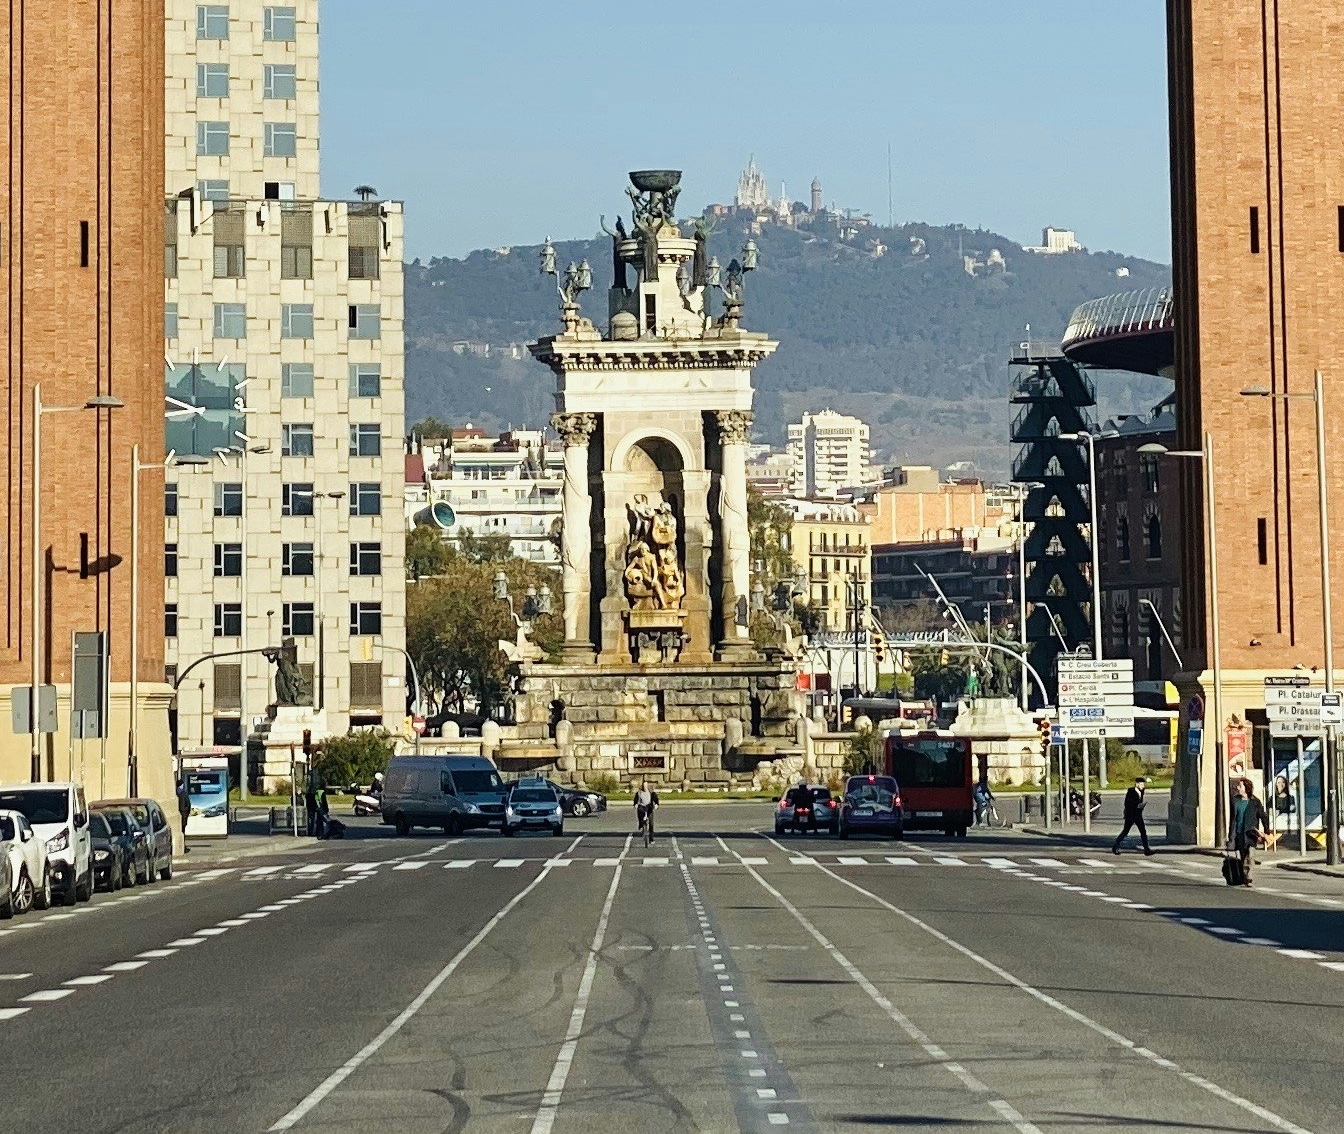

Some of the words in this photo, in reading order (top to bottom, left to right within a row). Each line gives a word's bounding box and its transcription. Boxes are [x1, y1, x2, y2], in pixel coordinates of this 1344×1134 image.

[234, 396, 245, 410] 3
[1278, 690, 1288, 699] Pl.
[1279, 706, 1289, 715] Pl.
